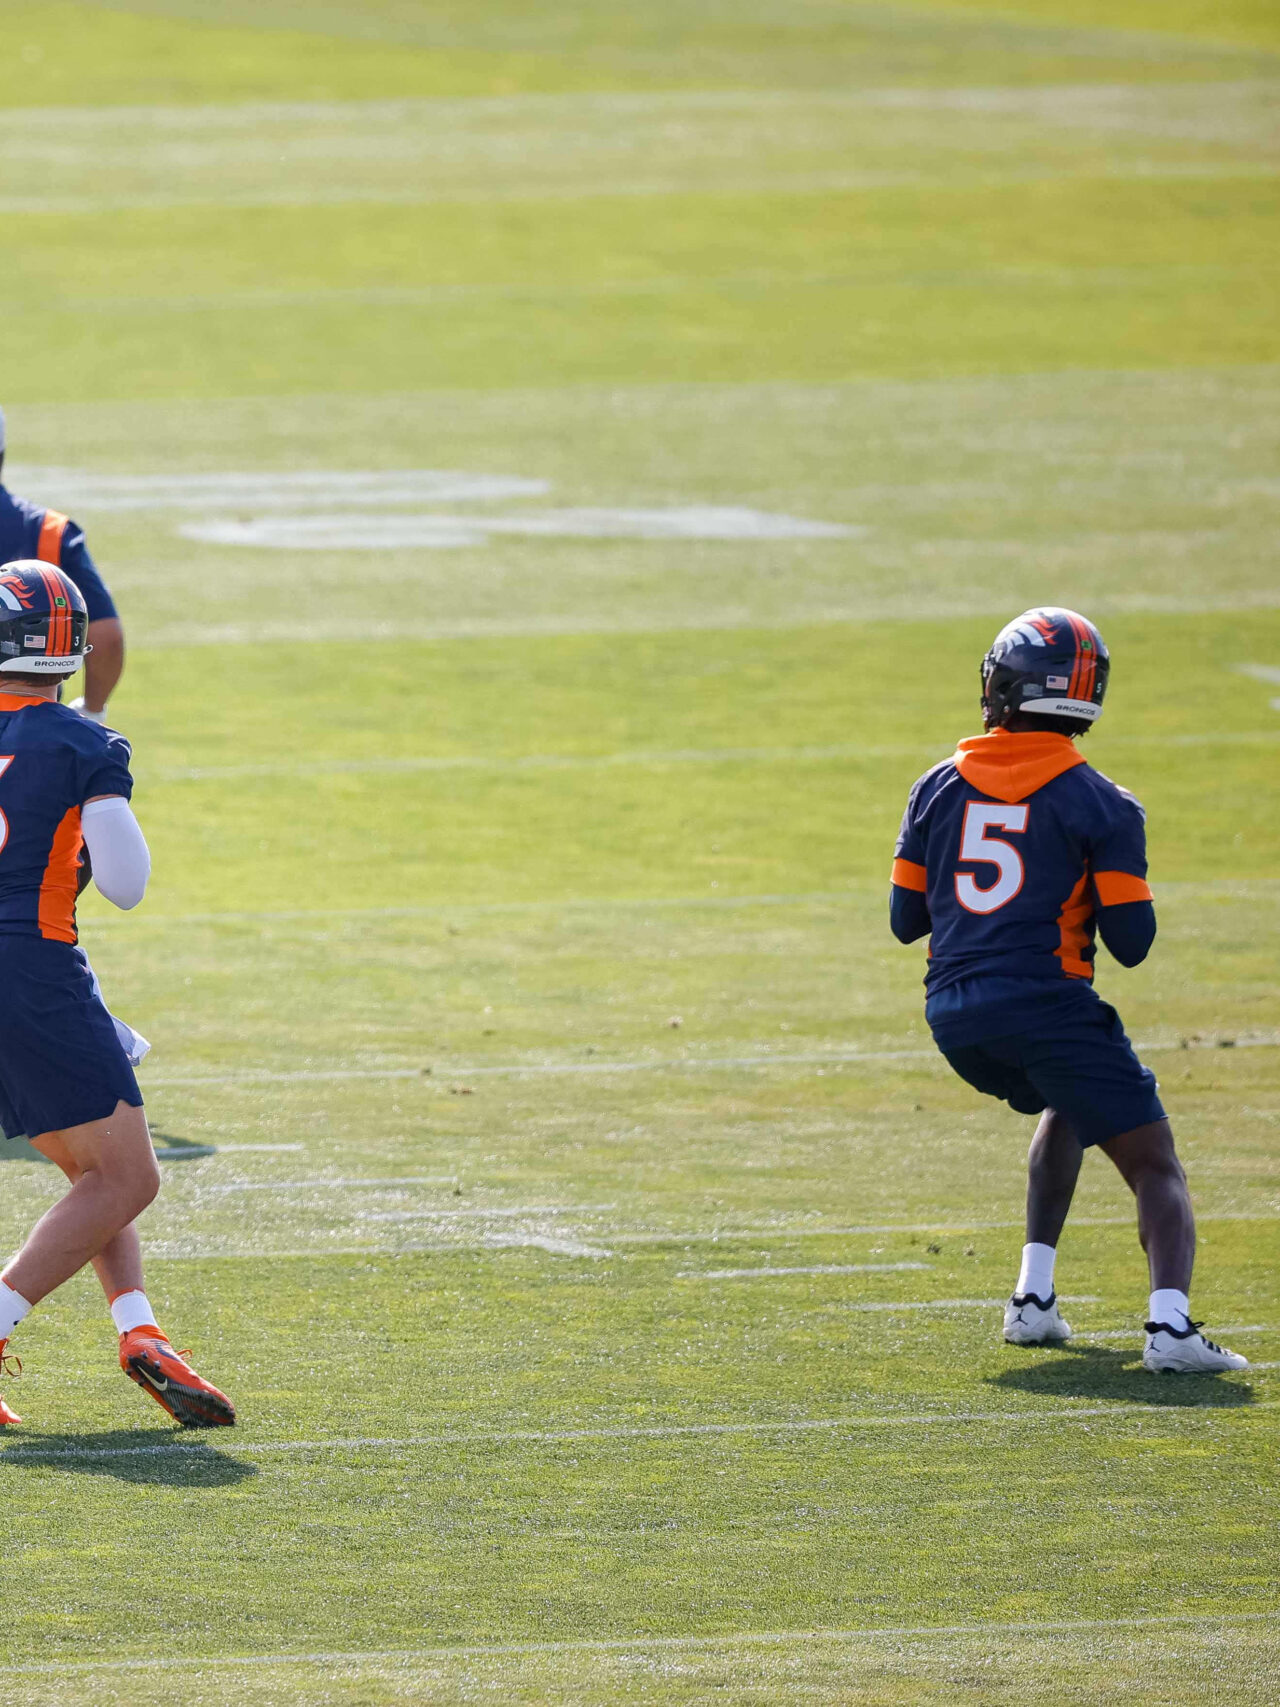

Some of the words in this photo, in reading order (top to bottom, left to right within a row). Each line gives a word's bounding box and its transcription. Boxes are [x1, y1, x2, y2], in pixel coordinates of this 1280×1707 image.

[74, 636, 80, 646] 3
[34, 659, 76, 667] BRONCOS
[1096, 682, 1102, 693] 5
[1055, 704, 1096, 716] BRONCOS
[953, 800, 1030, 915] 5
